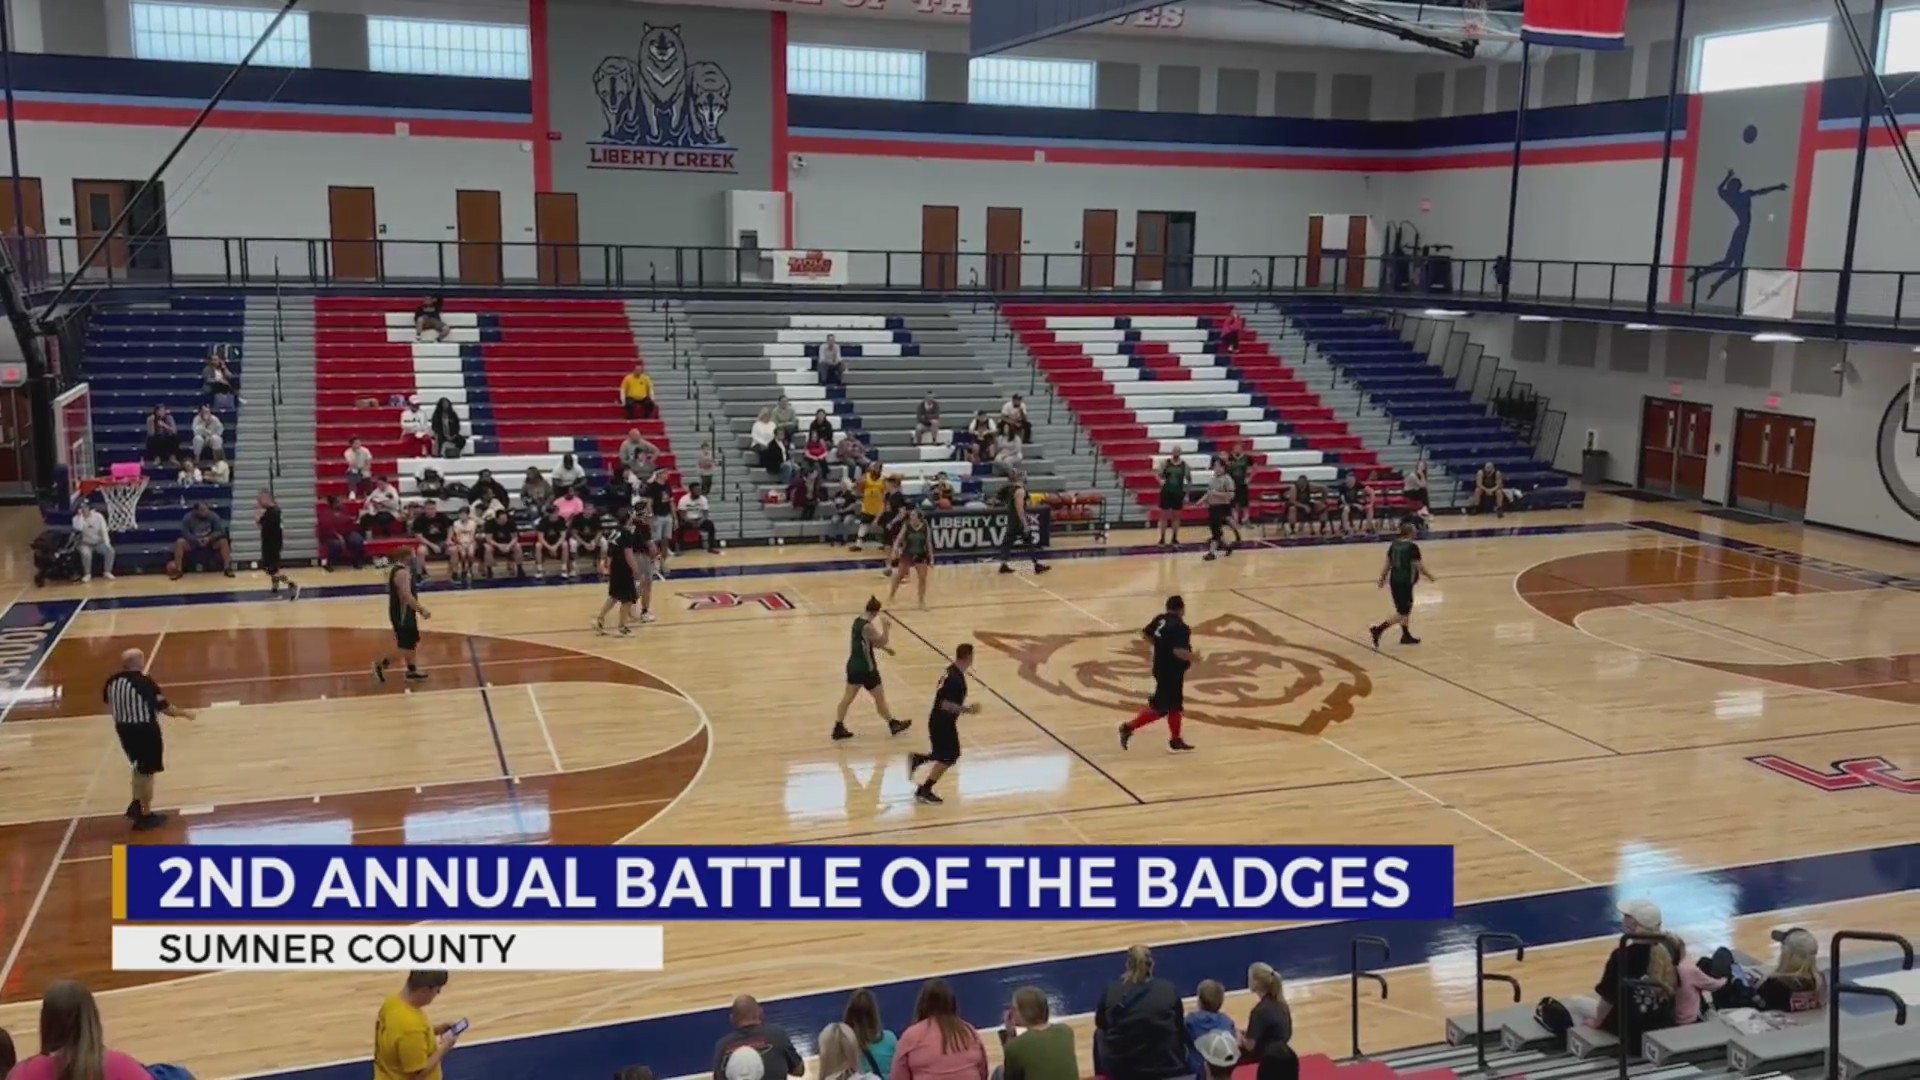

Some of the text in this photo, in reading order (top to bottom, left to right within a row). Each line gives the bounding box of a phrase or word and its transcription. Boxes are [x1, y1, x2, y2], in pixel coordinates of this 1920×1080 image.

[590, 148, 735, 168] LIBERTY CREEK
[931, 516, 992, 529] LIBERTY
[932, 526, 1040, 549] WOLVS
[1154, 619, 1167, 637] 2
